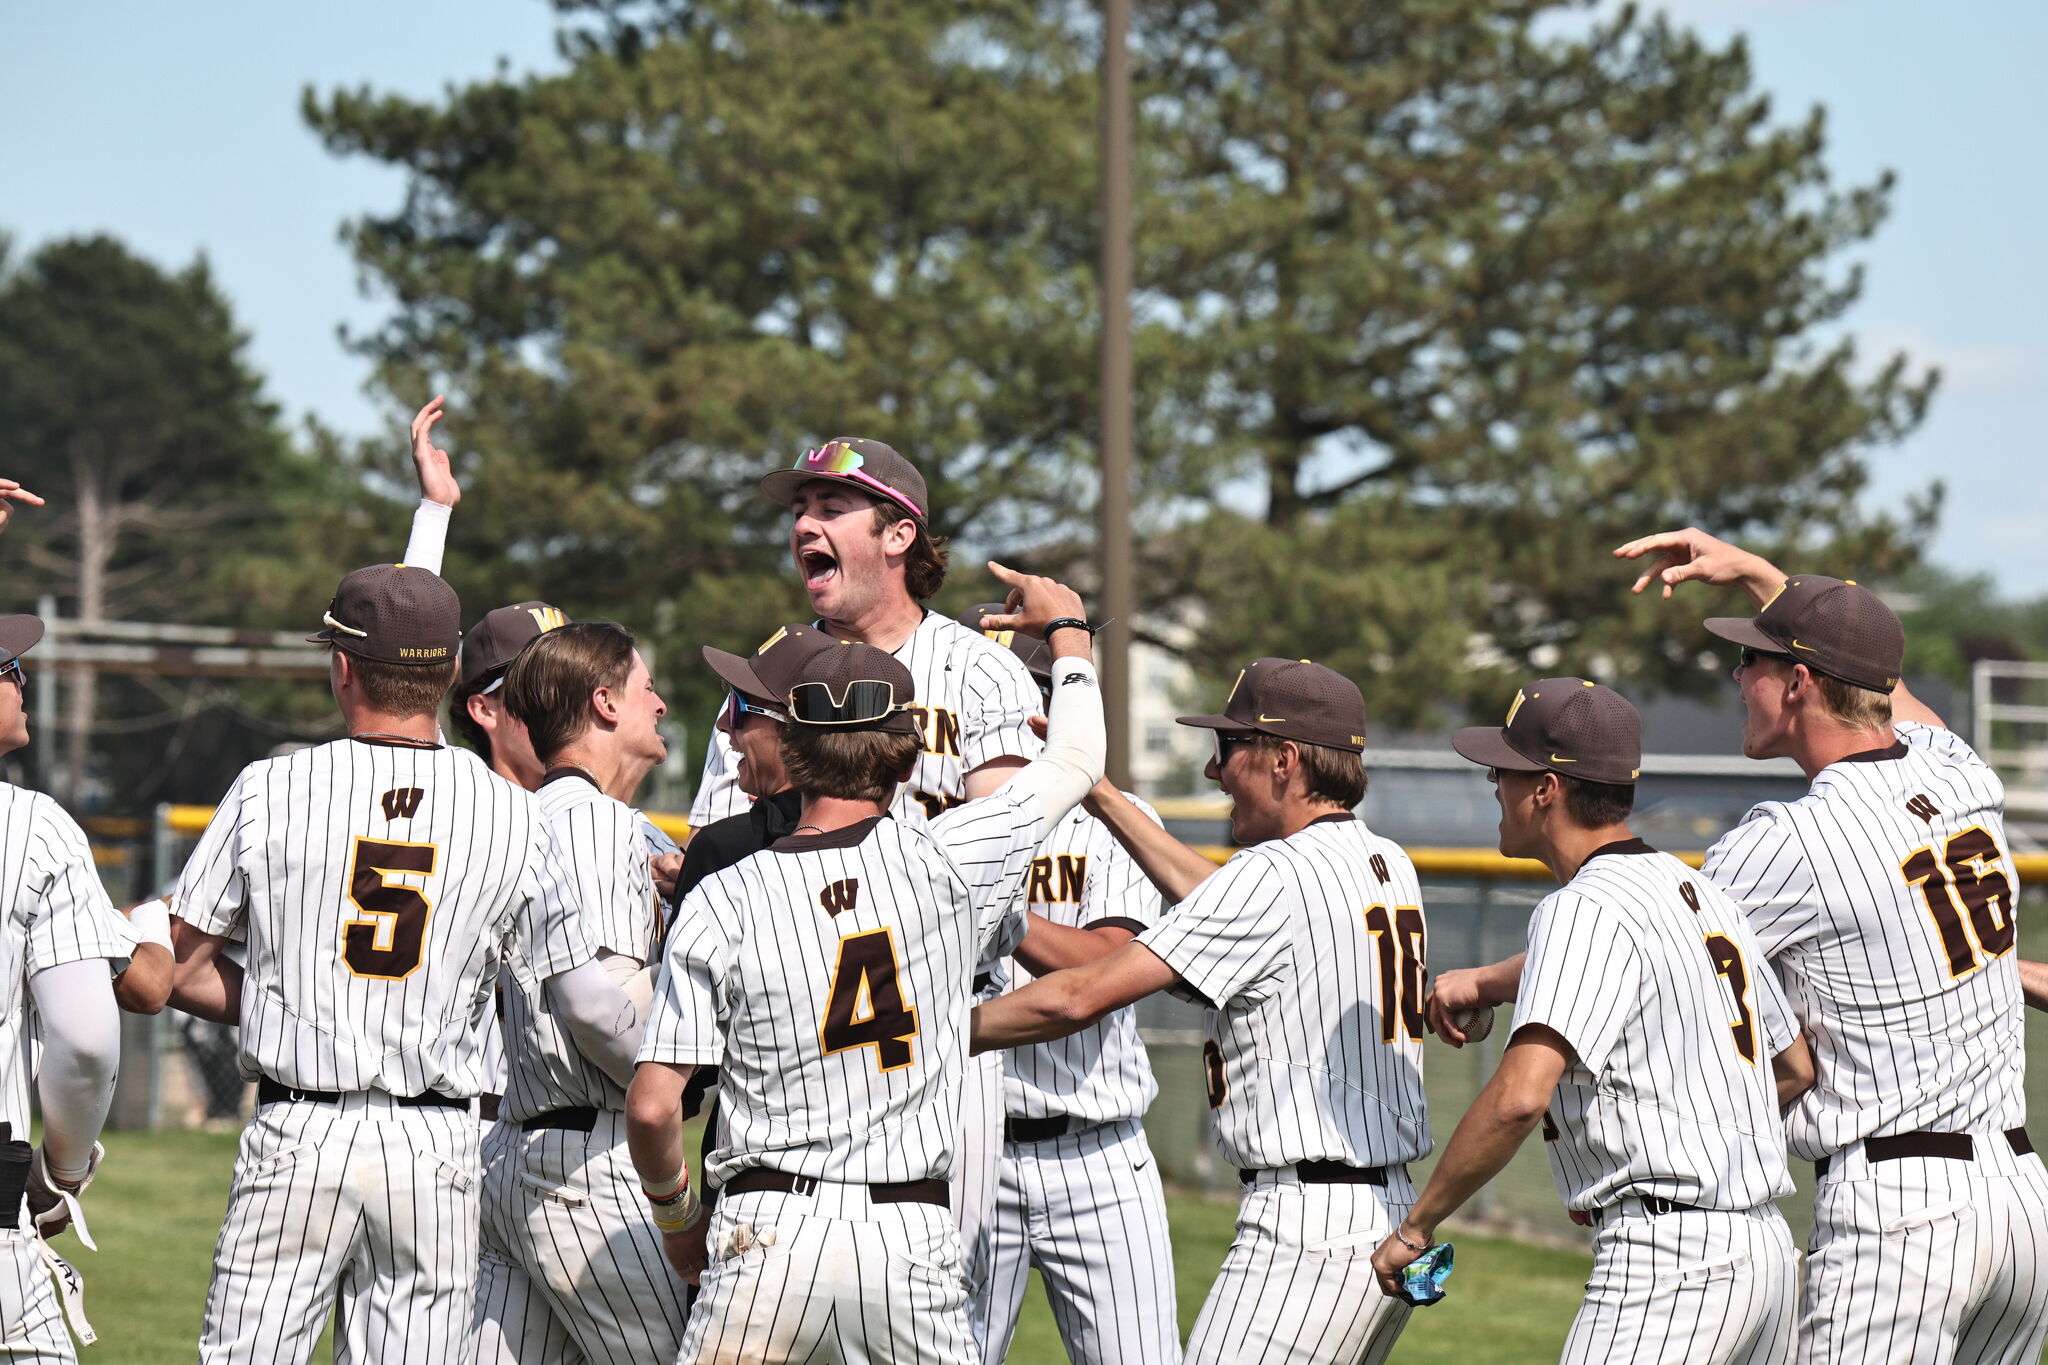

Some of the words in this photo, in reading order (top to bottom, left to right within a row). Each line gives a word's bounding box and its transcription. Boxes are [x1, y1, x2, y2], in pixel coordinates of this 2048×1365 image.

[399, 647, 448, 658] WARRIORS
[381, 786, 425, 822] W
[1906, 793, 1942, 825] W
[1369, 853, 1391, 886] W
[341, 835, 439, 981] 5
[820, 877, 859, 919] W
[1898, 824, 2016, 981] 16
[1363, 902, 1428, 1045] 10
[819, 926, 920, 1074] 4
